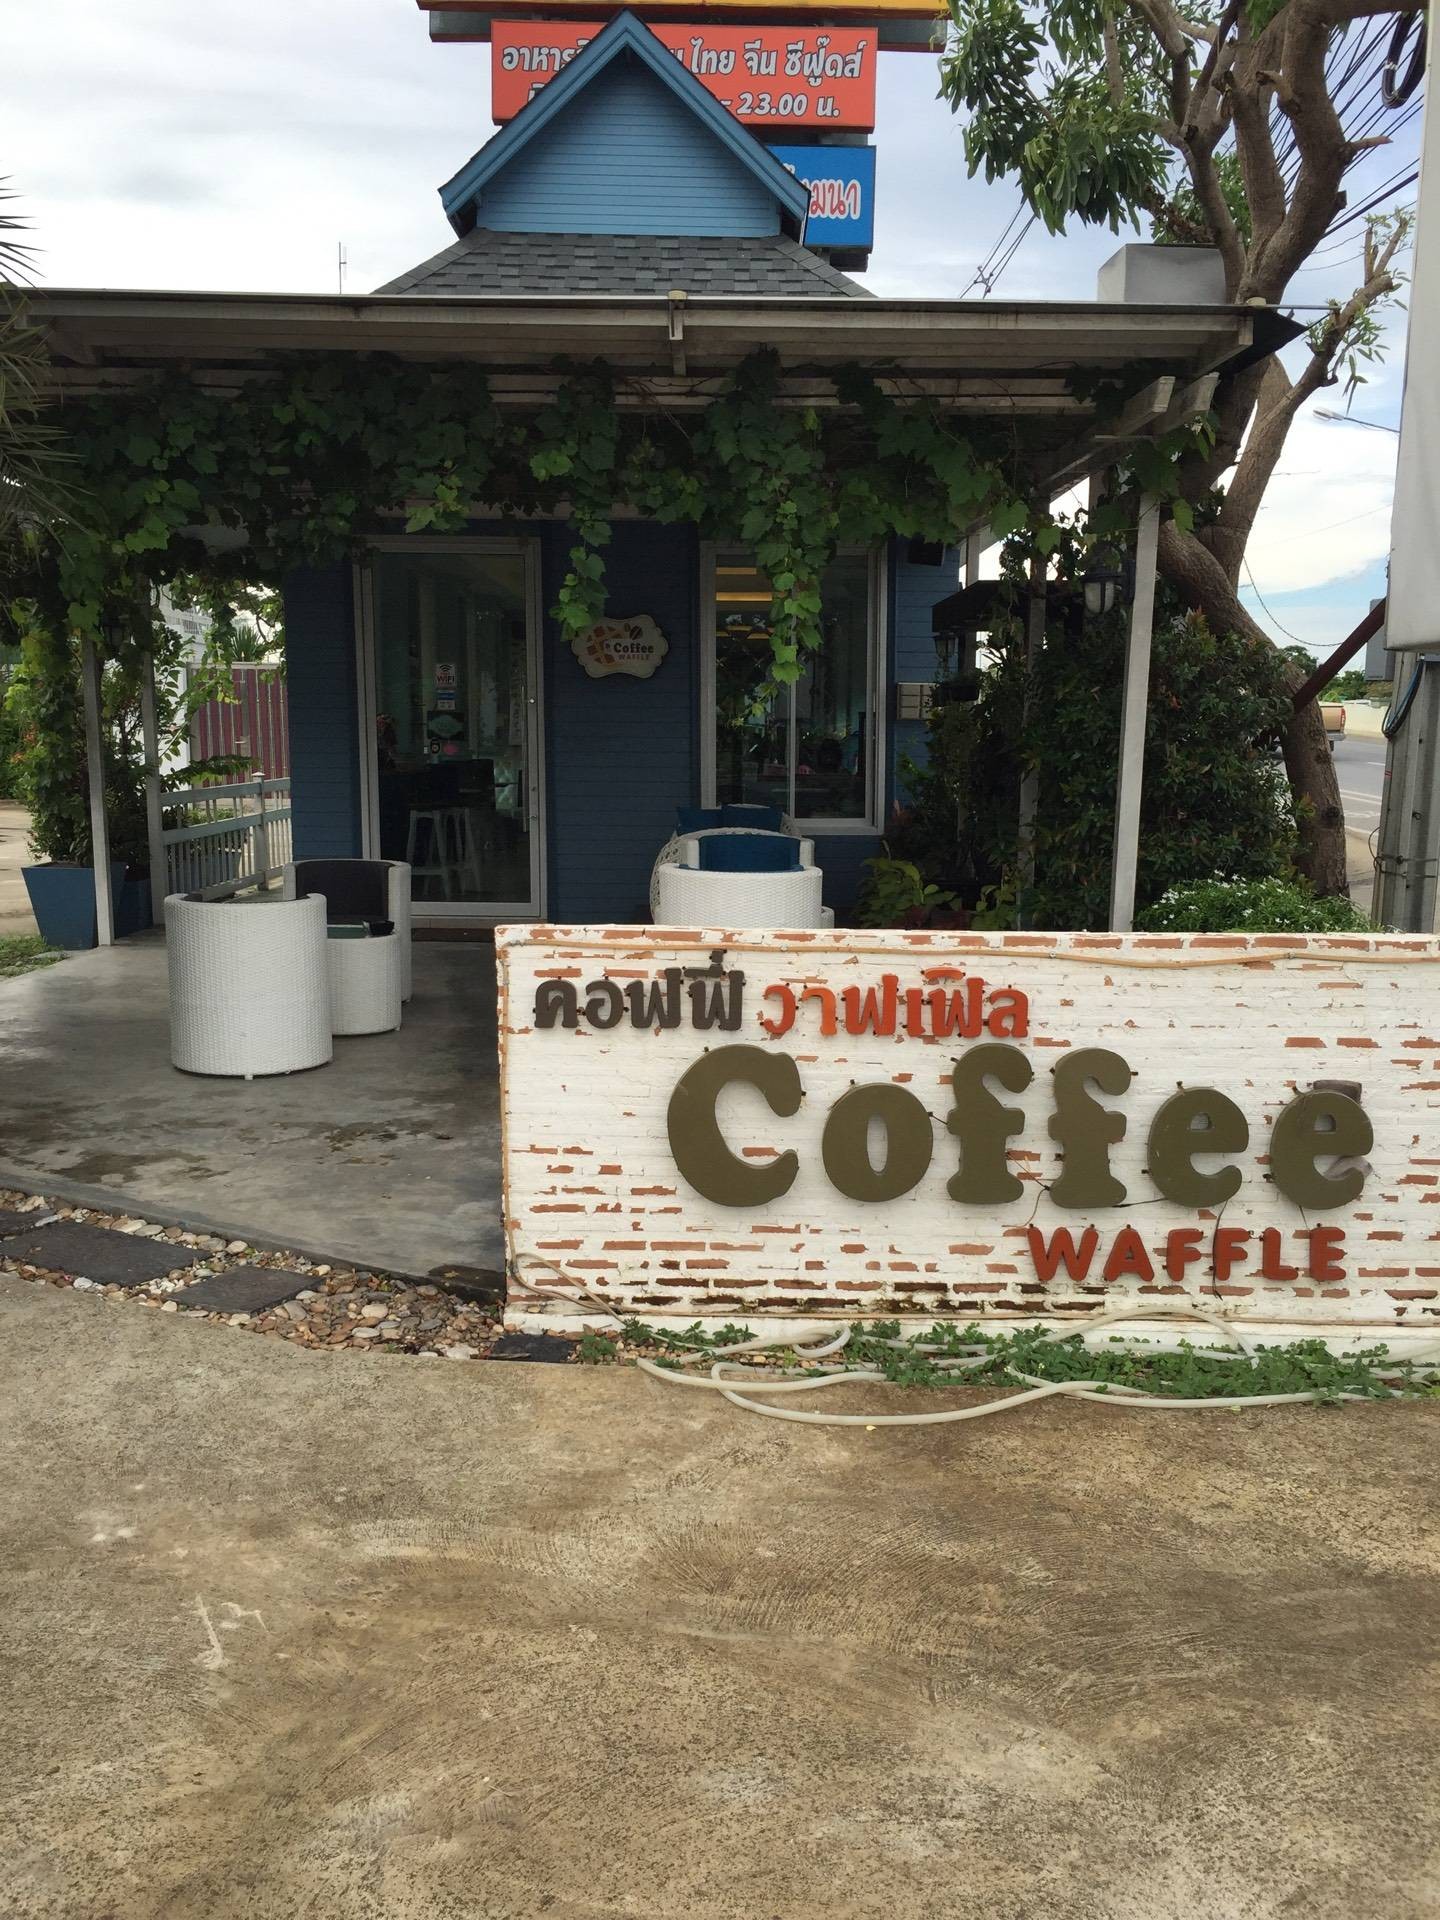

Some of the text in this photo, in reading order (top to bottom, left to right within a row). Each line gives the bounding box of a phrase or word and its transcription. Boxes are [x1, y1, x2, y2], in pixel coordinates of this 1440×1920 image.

[743, 39, 777, 76] จีน
[736, 92, 807, 117] 23.00
[816, 96, 840, 117] น.
[614, 643, 654, 653] Coffee
[534, 949, 1029, 1038] คอฟฟี่ วาฟเฟิล
[667, 1043, 1374, 1209] Coffee
[1029, 1226, 1347, 1282] WAFFLE
